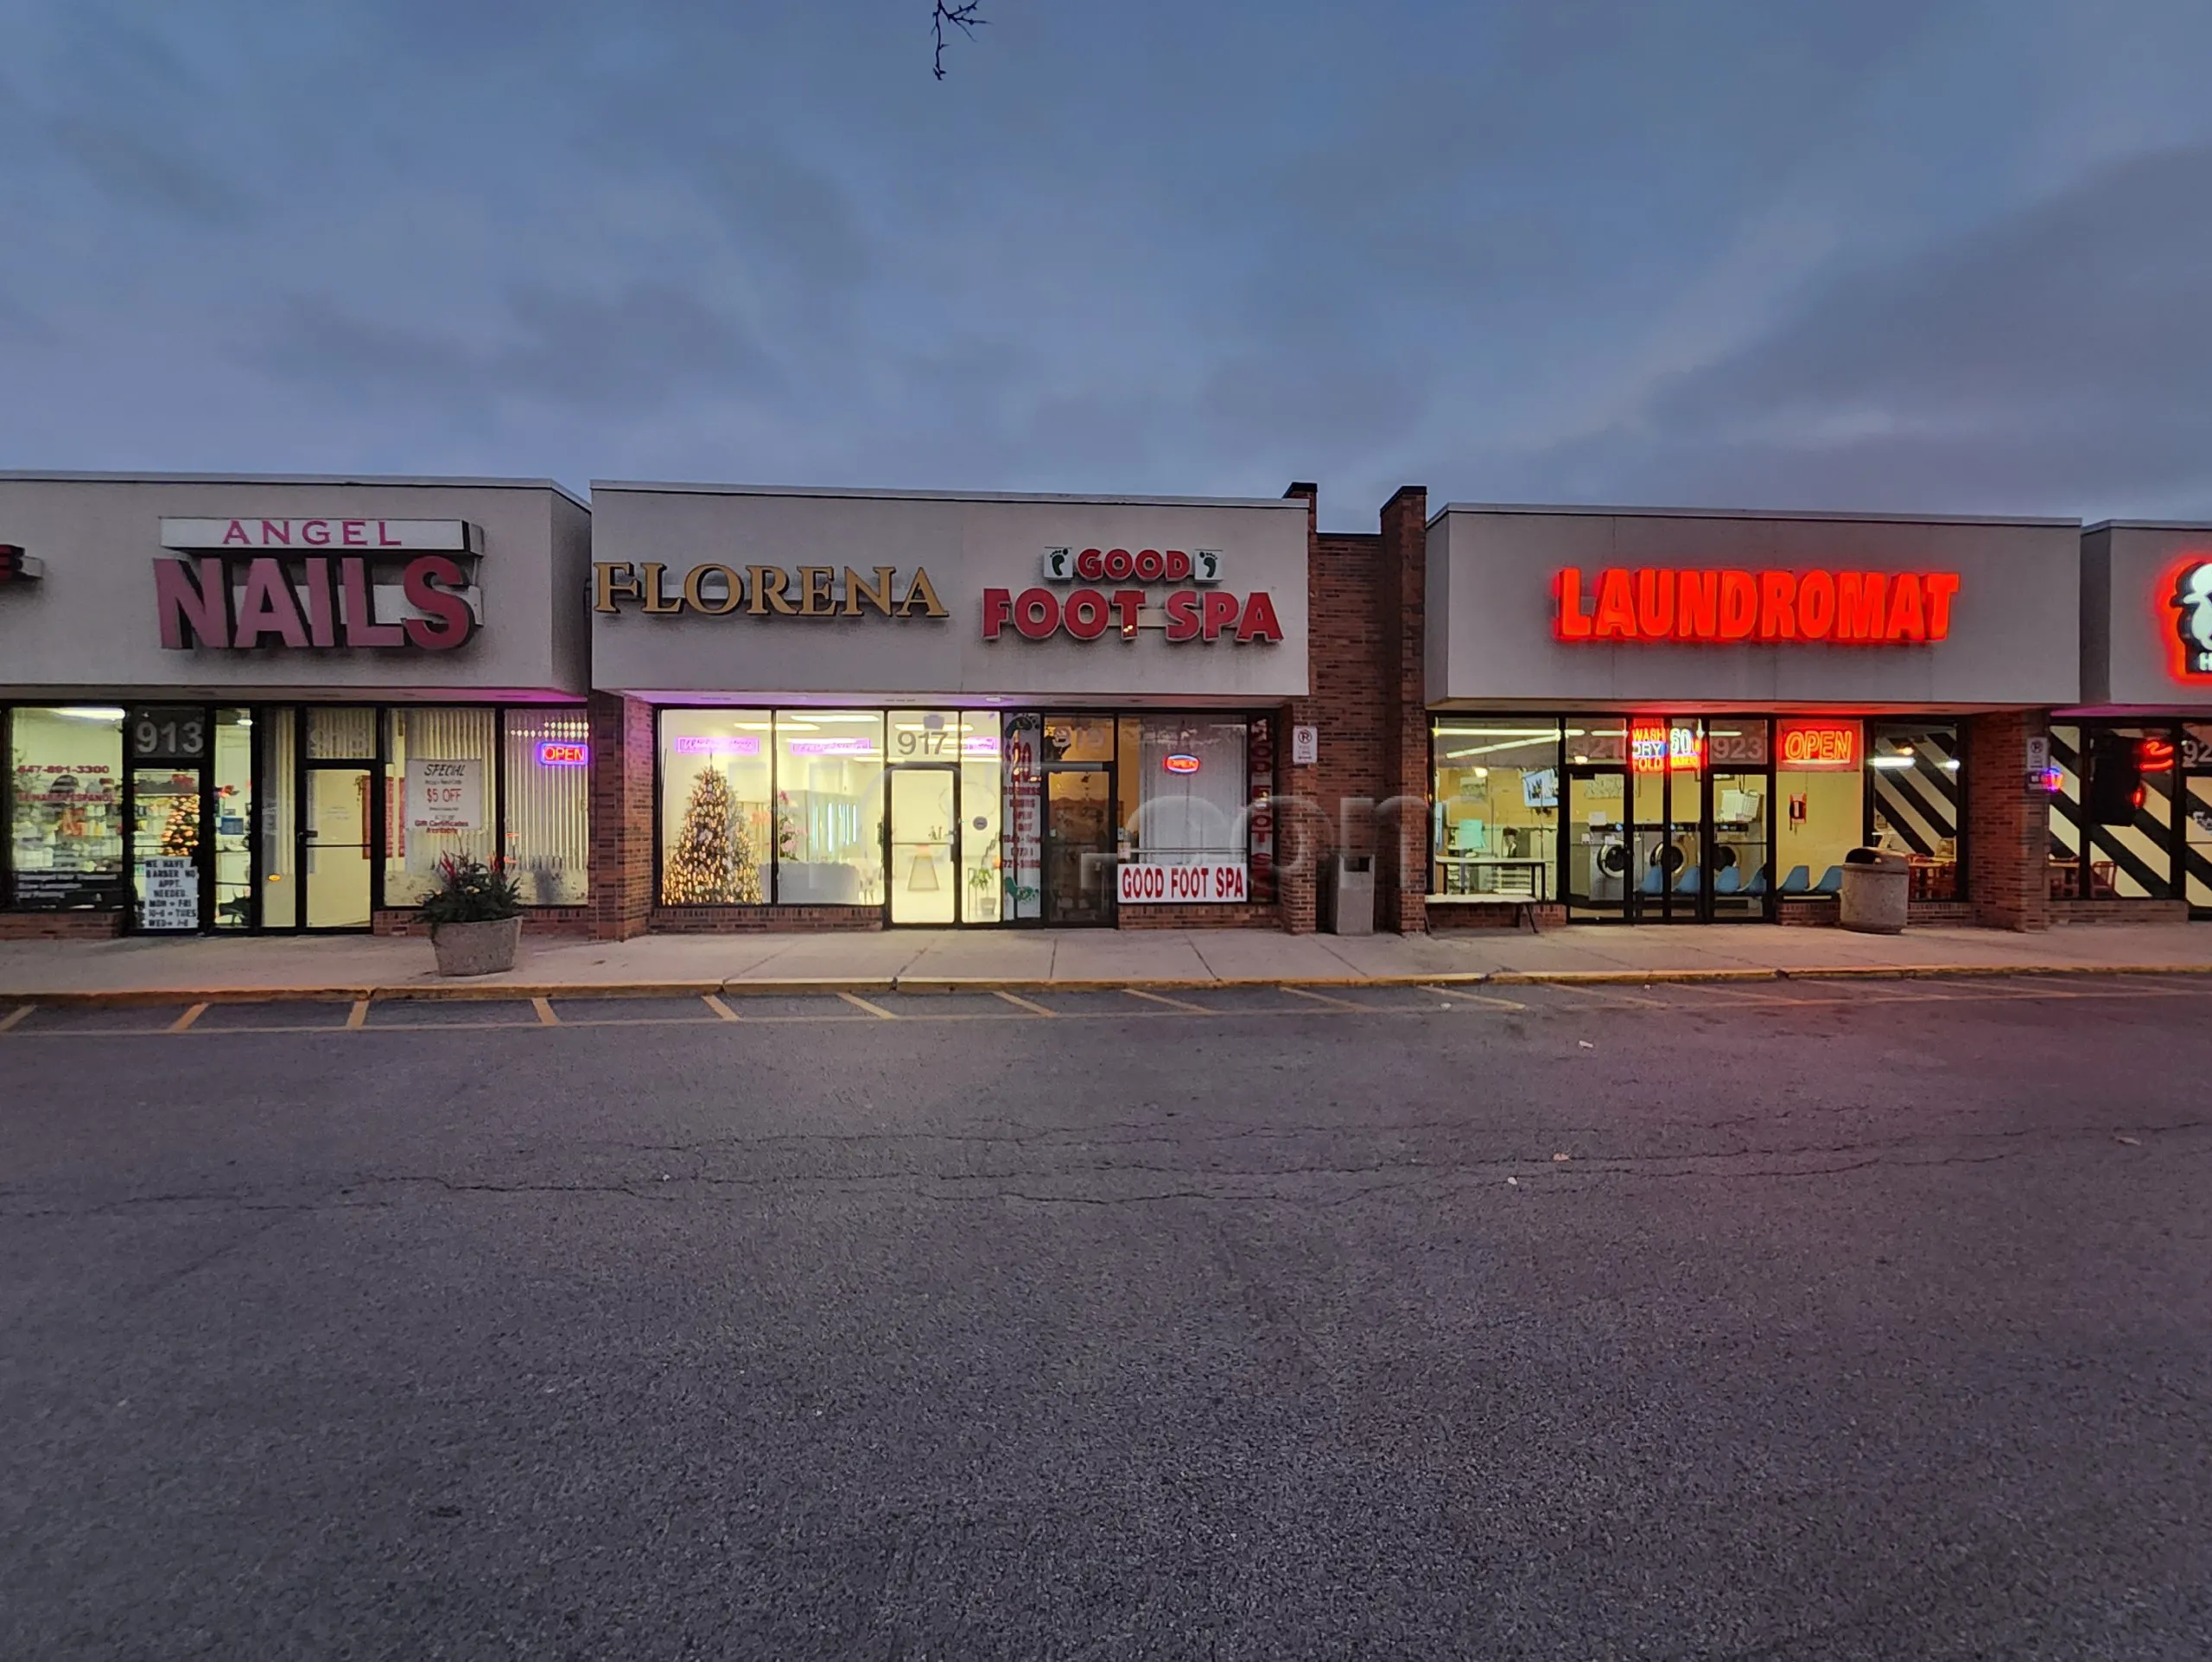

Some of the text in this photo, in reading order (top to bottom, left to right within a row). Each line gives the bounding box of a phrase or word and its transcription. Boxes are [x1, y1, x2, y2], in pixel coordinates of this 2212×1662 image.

[222, 520, 402, 546] ANGEL
[1077, 548, 1190, 582] GOOD
[153, 556, 469, 649] NAILS
[593, 561, 949, 619] FLORENA
[982, 587, 1283, 643] FOOT SPA
[1556, 568, 1960, 642] LAUNDROMAT
[136, 722, 204, 753] 913
[897, 731, 949, 755] 917
[1631, 727, 1666, 742] WASH
[1670, 728, 1692, 755] 60
[1785, 730, 1853, 761] OPEN
[543, 746, 585, 761] OPEN
[1632, 742, 1662, 756] DRY
[1713, 737, 1764, 759] 923
[424, 764, 466, 776] SPECIAL
[1632, 758, 1663, 772] FOLD
[427, 788, 462, 803] $5 OFF
[146, 869, 179, 878] BARBER
[1122, 867, 1244, 898] GOOD FOOT SPA
